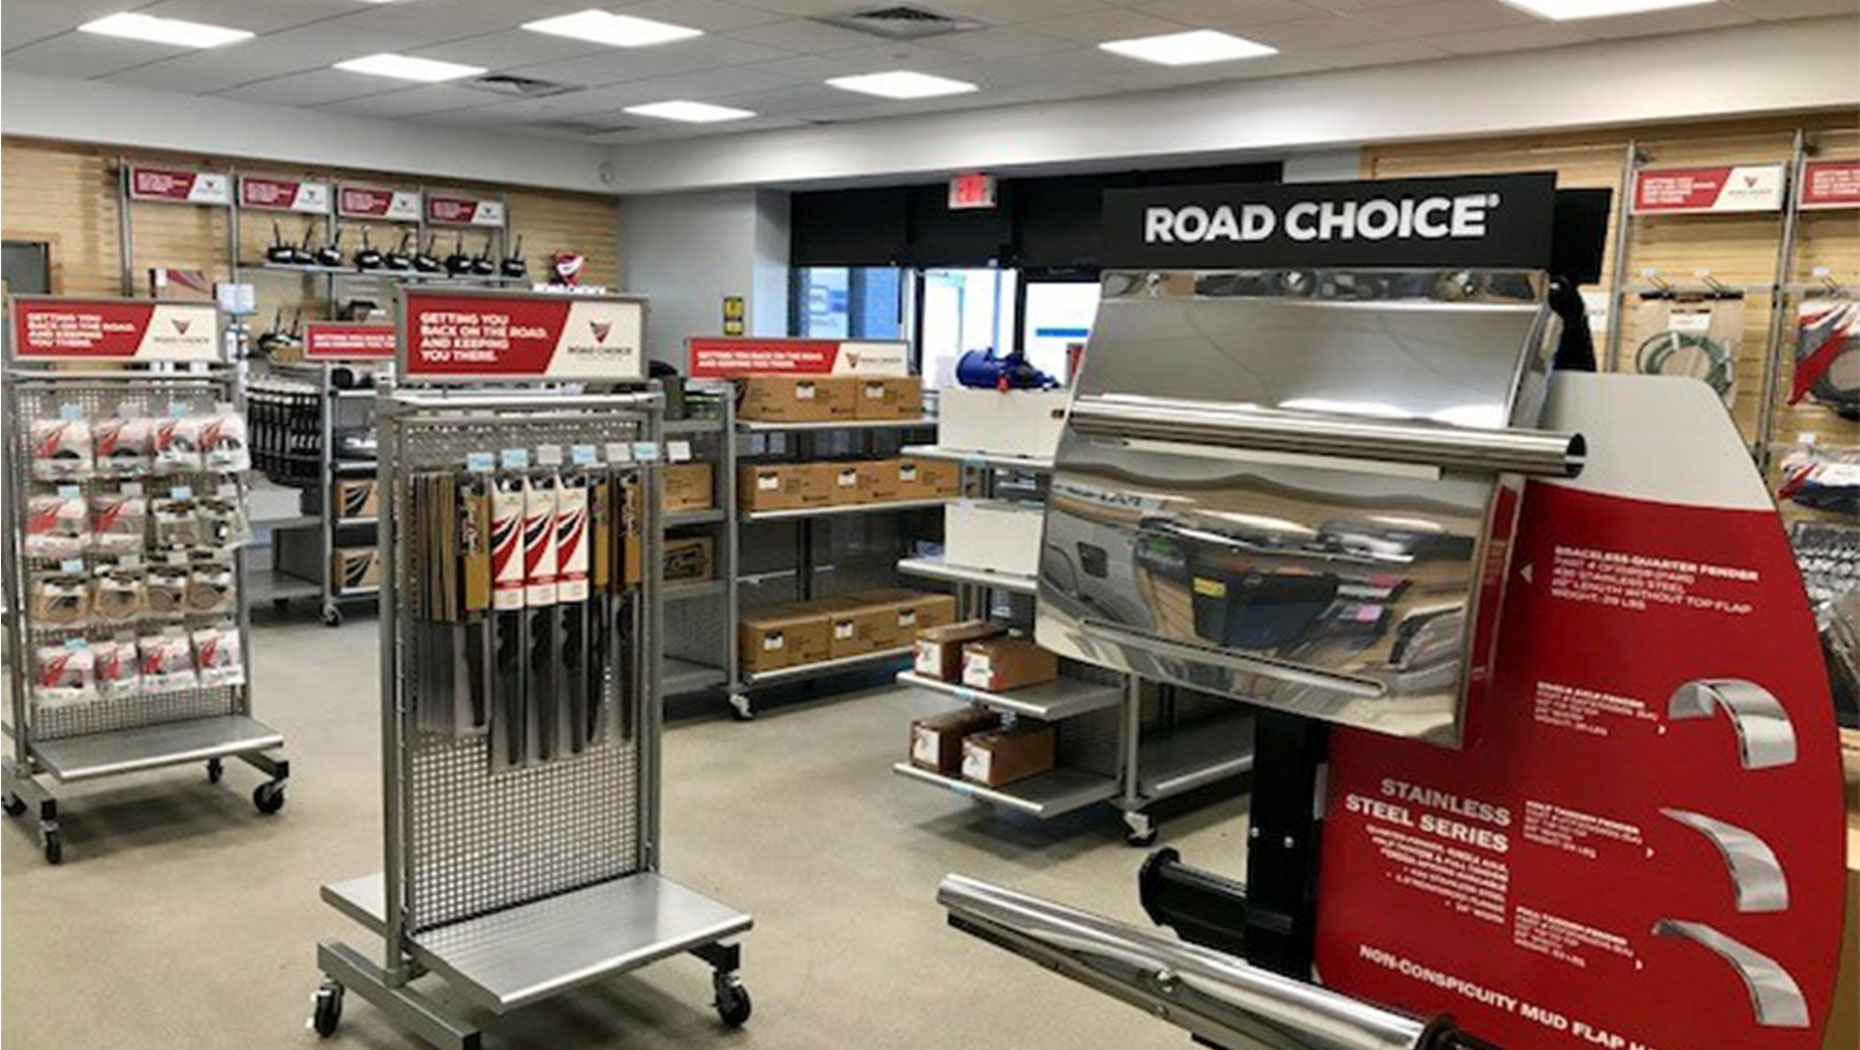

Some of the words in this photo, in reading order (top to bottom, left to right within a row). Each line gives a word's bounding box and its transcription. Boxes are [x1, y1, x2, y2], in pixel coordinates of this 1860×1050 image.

[1144, 204, 1276, 243] ROAD
[420, 312, 478, 325] GETTING
[481, 314, 509, 325] YOU
[420, 325, 455, 337] BACK
[459, 327, 481, 337] ON
[420, 338, 451, 349] AND
[454, 338, 509, 350] KEEPING
[421, 349, 450, 361] YOU
[1700, 563, 1760, 581] FENDER
[1380, 777, 1512, 826] STAINLESS
[1345, 794, 1414, 828] STEEL
[1419, 813, 1509, 853] SERIES
[1358, 943, 1518, 1013] NON-CONSPICUITY
[1519, 1002, 1568, 1032] MUD
[1571, 1020, 1626, 1050] FLAP
